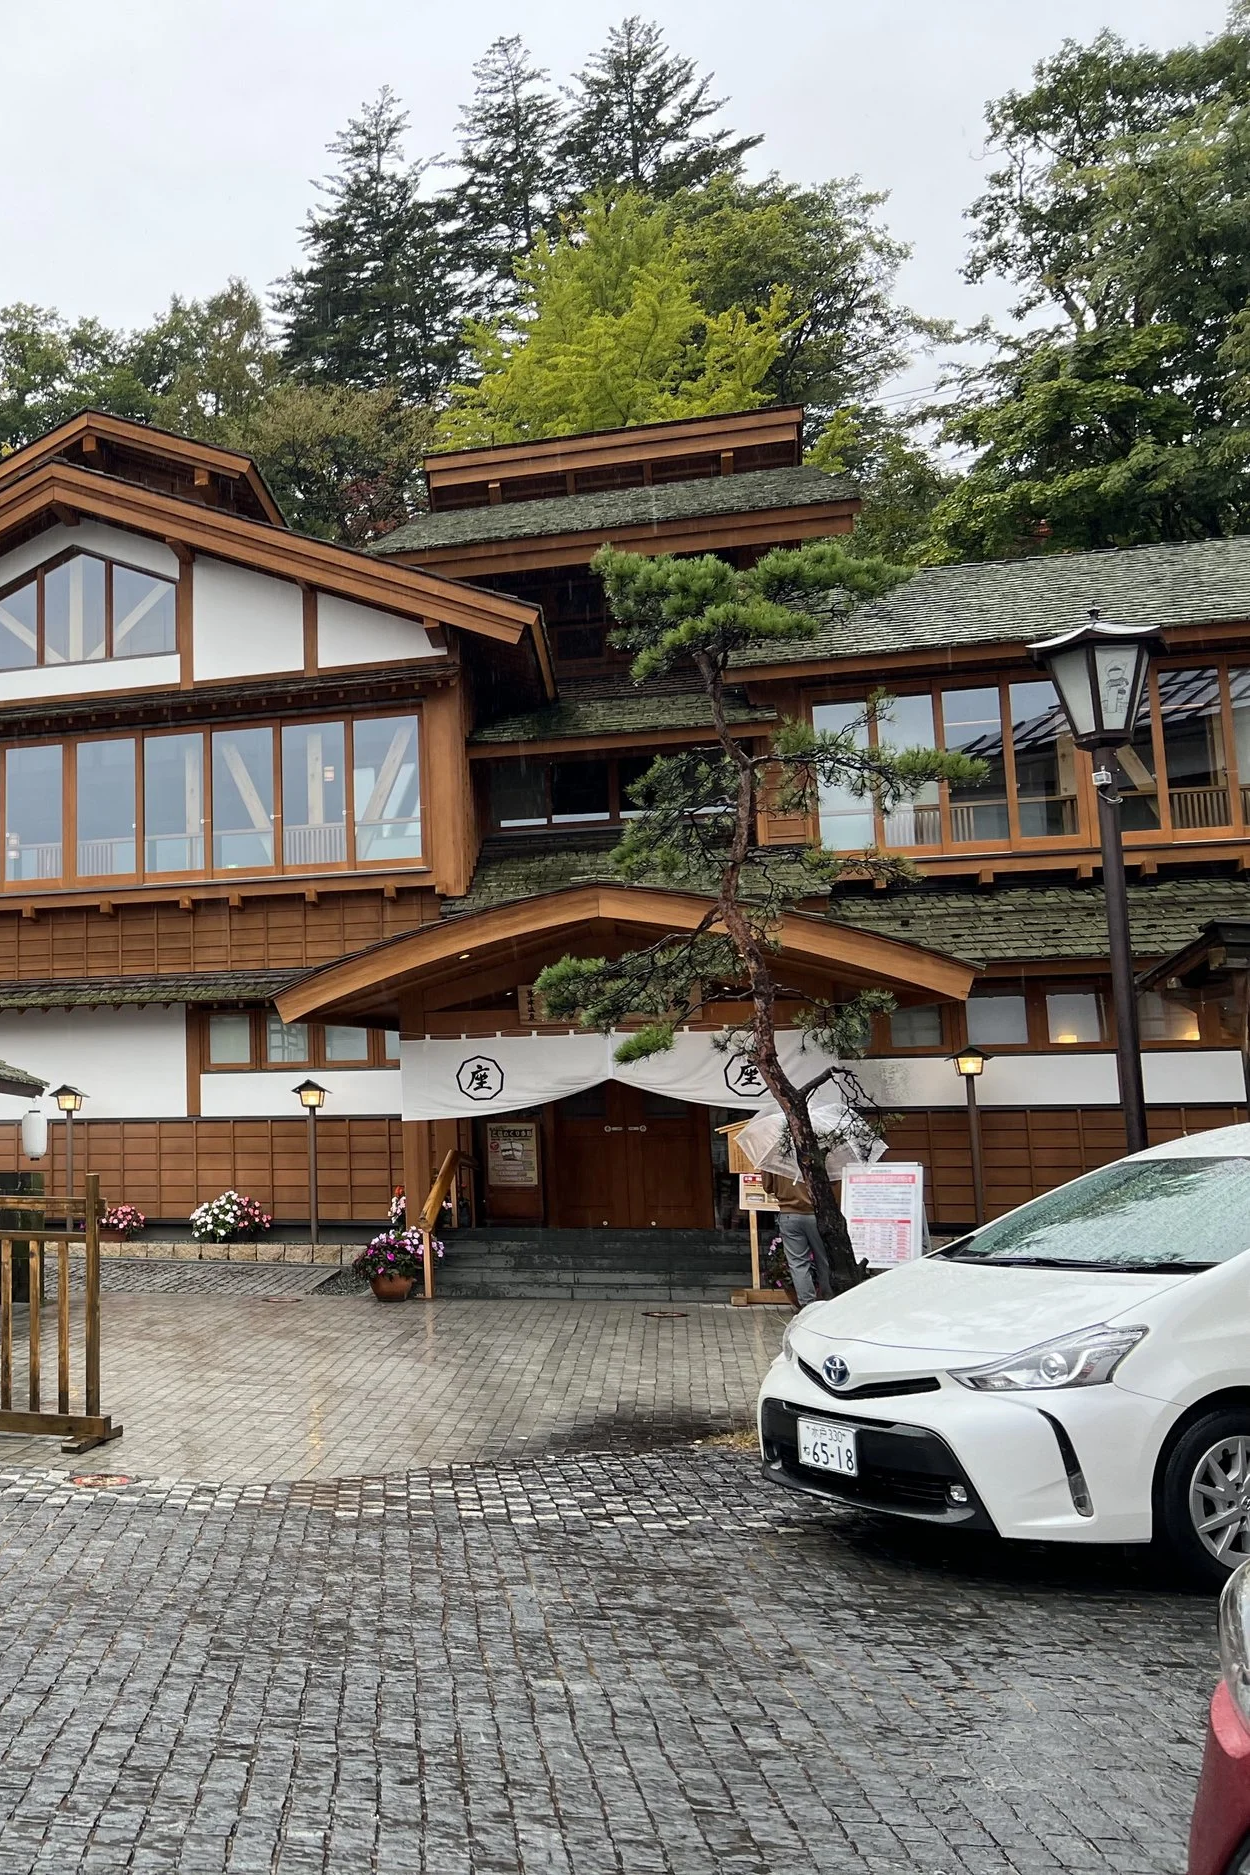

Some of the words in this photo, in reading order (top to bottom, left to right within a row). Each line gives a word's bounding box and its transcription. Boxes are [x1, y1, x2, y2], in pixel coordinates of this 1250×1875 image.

[467, 1064, 493, 1092] 座
[733, 1061, 761, 1087] 座
[812, 1441, 854, 1471] 65-18
